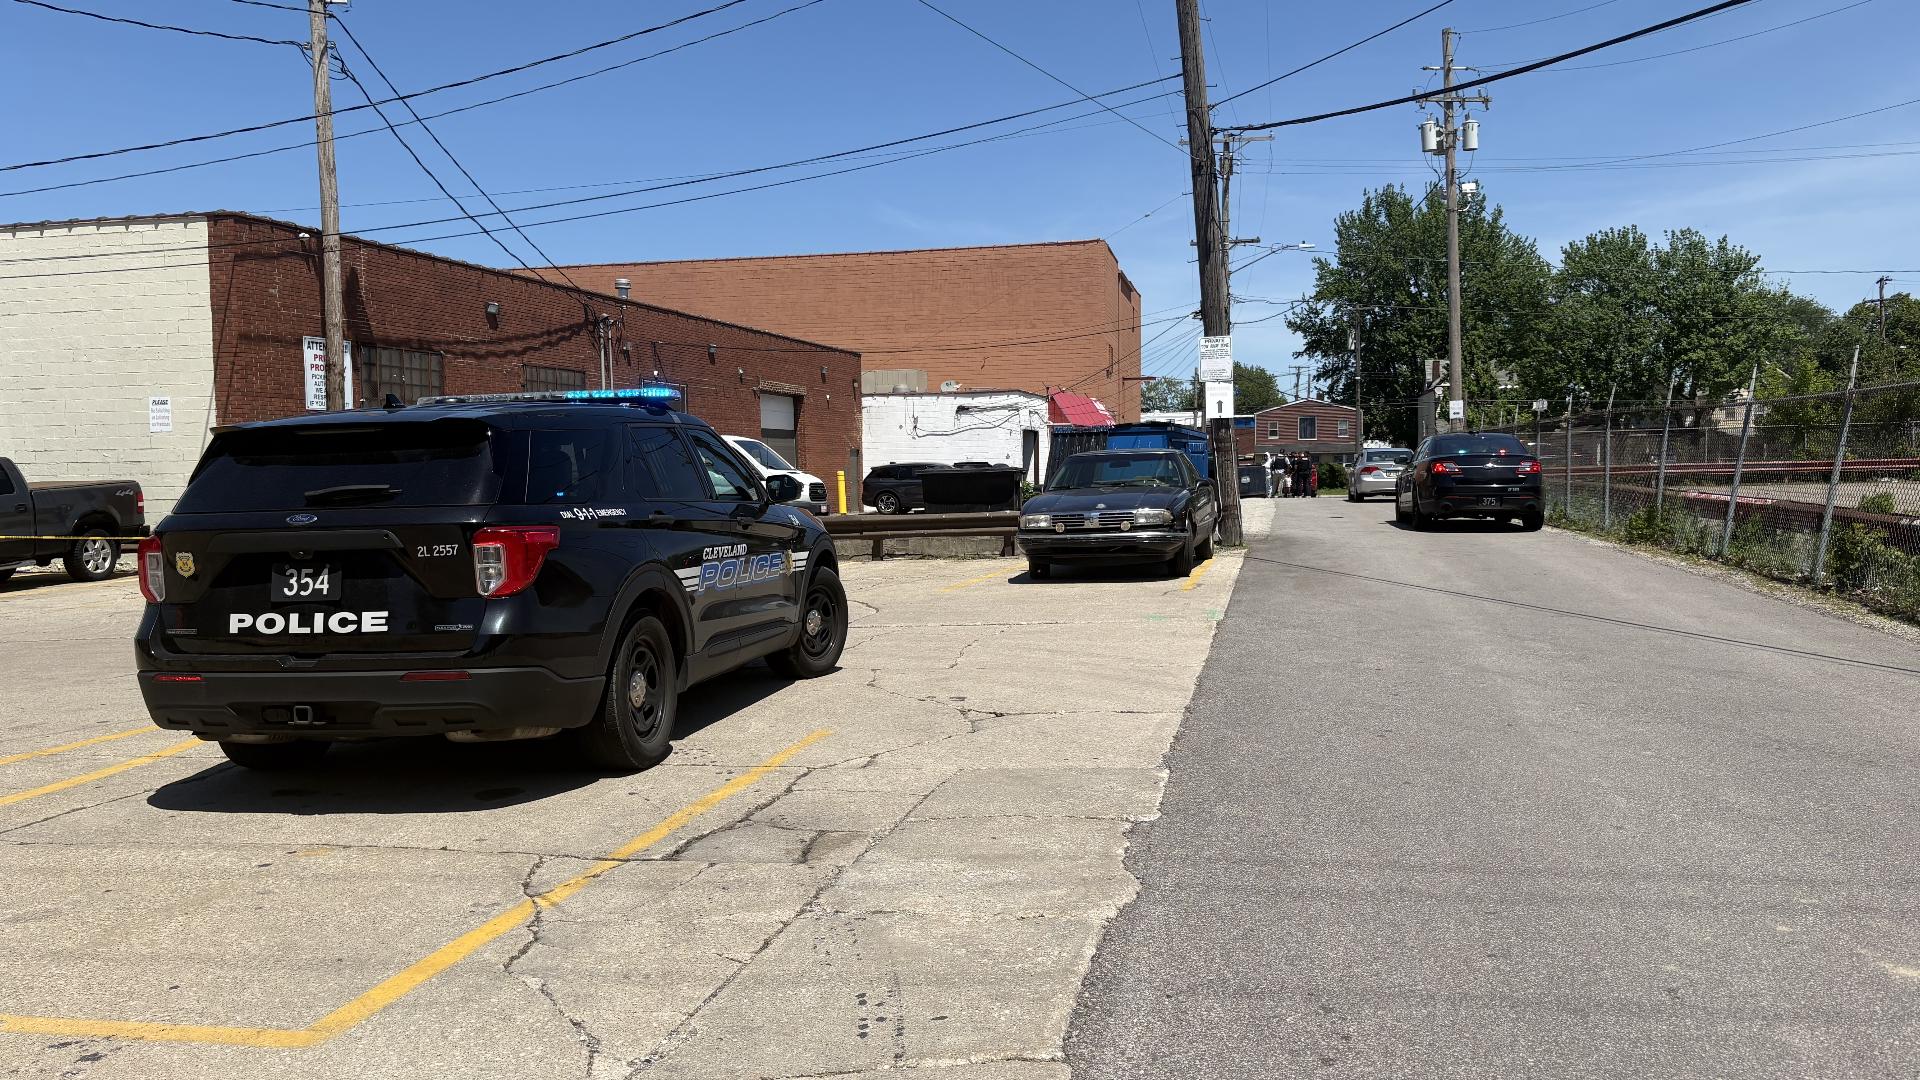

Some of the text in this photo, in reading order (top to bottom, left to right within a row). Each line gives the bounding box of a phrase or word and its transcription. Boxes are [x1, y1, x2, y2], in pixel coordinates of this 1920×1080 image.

[1482, 497, 1496, 506] 375
[560, 507, 628, 521] DIAL 9-1-1 EMERGENCY
[417, 544, 459, 558] 2L 2557
[702, 543, 748, 560] CLEVELAND
[699, 552, 783, 592] POLICE
[283, 567, 330, 597] 354
[229, 610, 390, 635] POLICE
